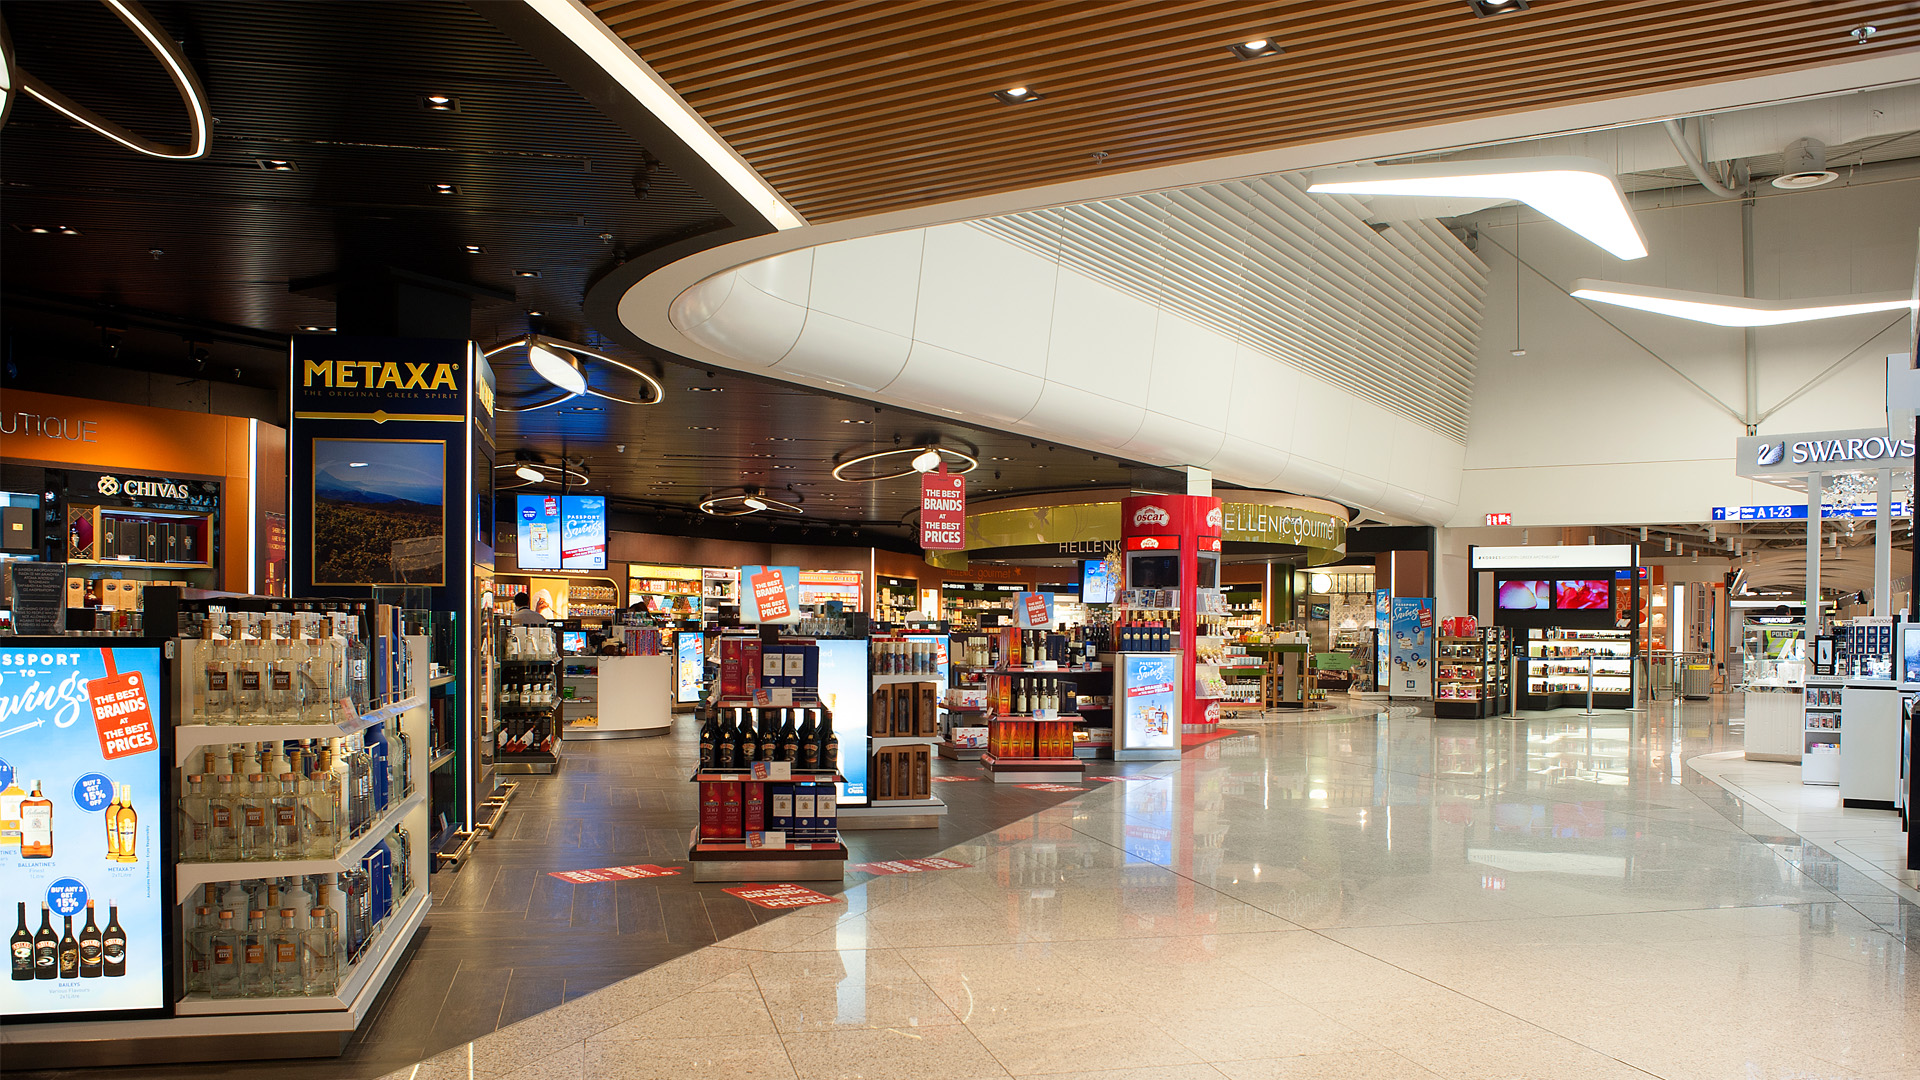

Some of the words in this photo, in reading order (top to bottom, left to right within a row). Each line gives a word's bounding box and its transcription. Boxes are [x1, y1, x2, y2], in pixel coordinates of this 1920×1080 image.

[303, 360, 458, 390] METAXA
[124, 480, 188, 499] CHIVAS
[942, 490, 960, 498] BEST
[924, 498, 962, 511] BRANDS
[1757, 507, 1766, 518] A
[1769, 506, 1791, 517] 1-23
[564, 520, 602, 538] Savings
[924, 531, 960, 543] PRICES
[978, 569, 1011, 580] gourmet
[756, 585, 784, 598] BRANDS
[761, 605, 787, 617] PRICES
[1392, 607, 1419, 621] Savings
[2, 654, 80, 665] SSPORT
[1137, 665, 1164, 680] Savings
[94, 692, 115, 705] THE
[116, 688, 140, 700] BEST
[95, 697, 146, 720] BRANDS
[104, 728, 124, 740] THE
[126, 722, 148, 735] BEST
[106, 732, 153, 753] PRICES
[83, 790, 106, 802] 15%
[56, 898, 78, 907] 15%
